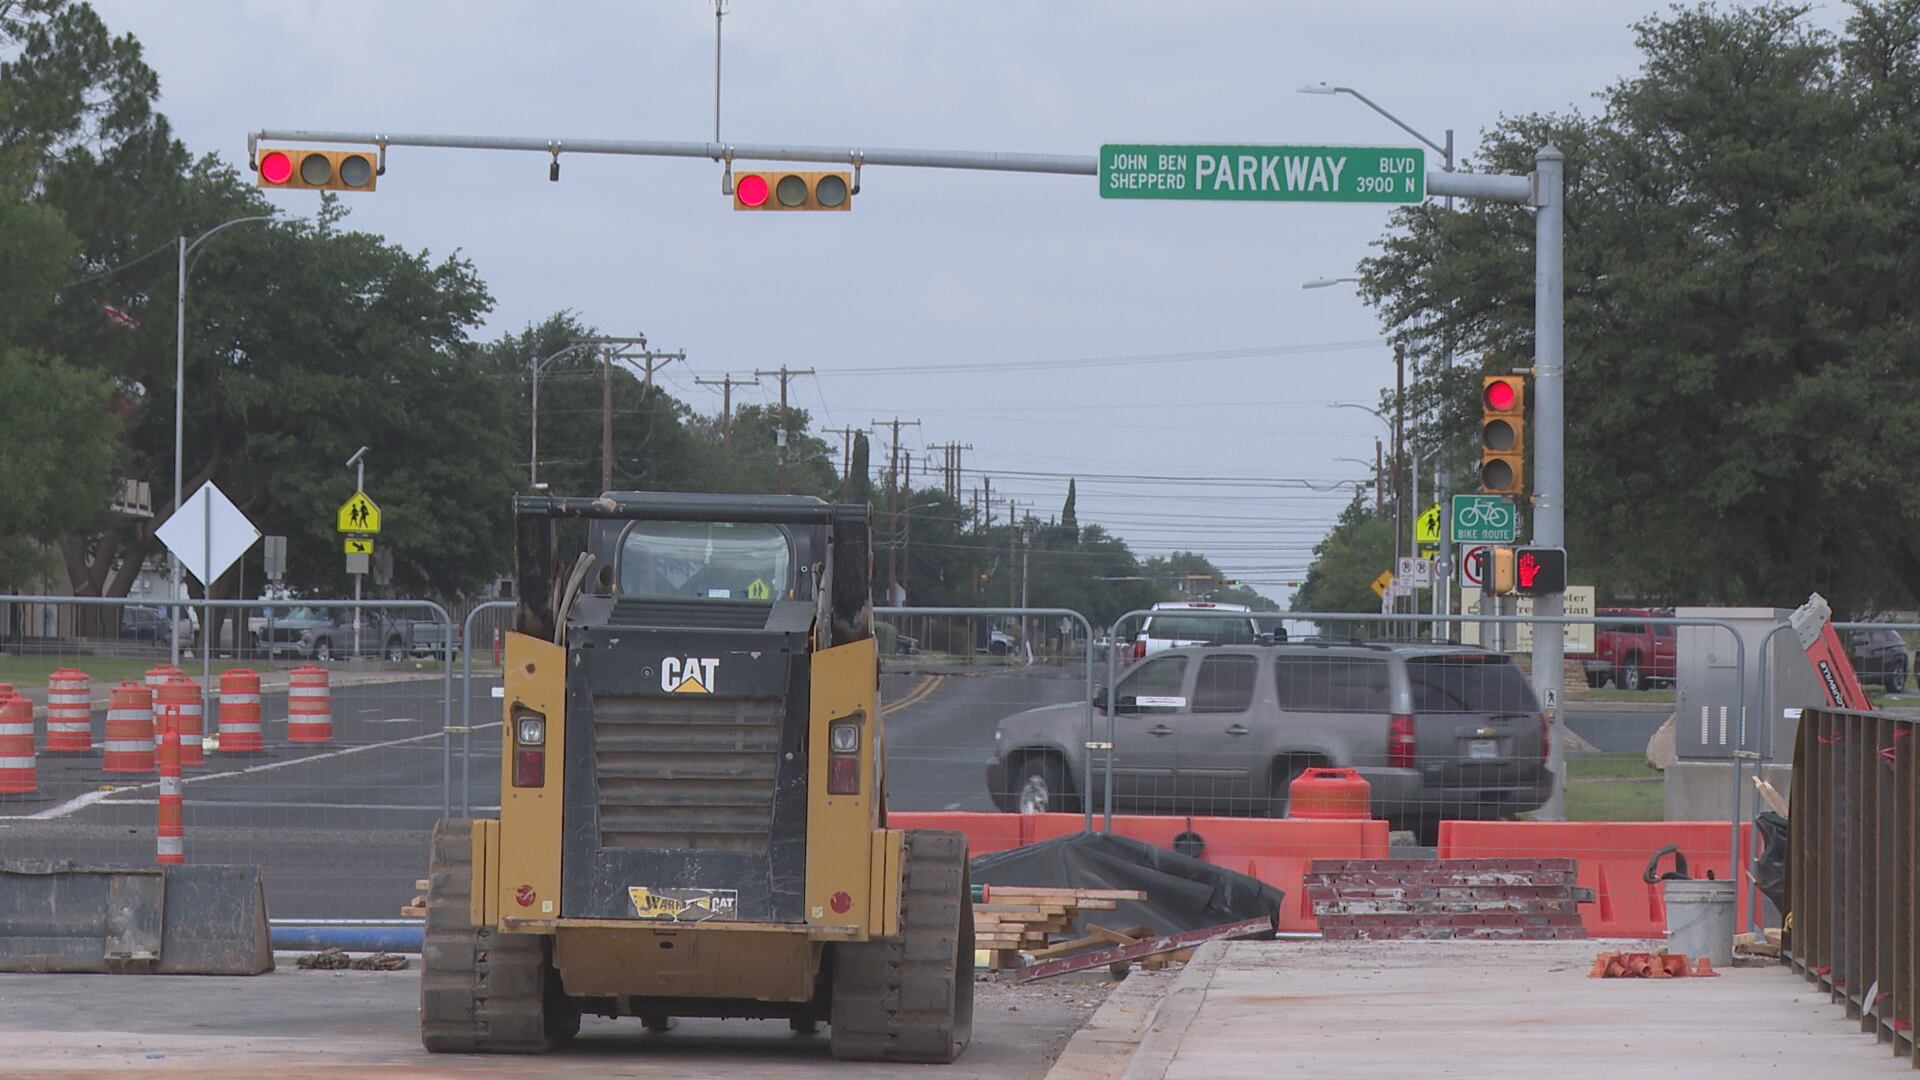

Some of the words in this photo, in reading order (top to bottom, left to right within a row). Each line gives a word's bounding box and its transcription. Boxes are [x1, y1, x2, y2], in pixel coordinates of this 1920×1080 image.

[1110, 154, 1147, 170] JOHN
[1159, 154, 1187, 171] BEN
[1379, 157, 1415, 174] BLVD
[1110, 173, 1186, 190] SHEPPERD
[1195, 154, 1347, 192] PARKWAY
[1356, 176, 1394, 193] 3900
[1405, 177, 1415, 193] N
[1458, 529, 1478, 539] BIKE
[1482, 529, 1509, 540] ROUTE
[661, 656, 720, 694] CAT
[1820, 660, 1845, 709] LOUISVILLE
[711, 897, 735, 912] CAT
